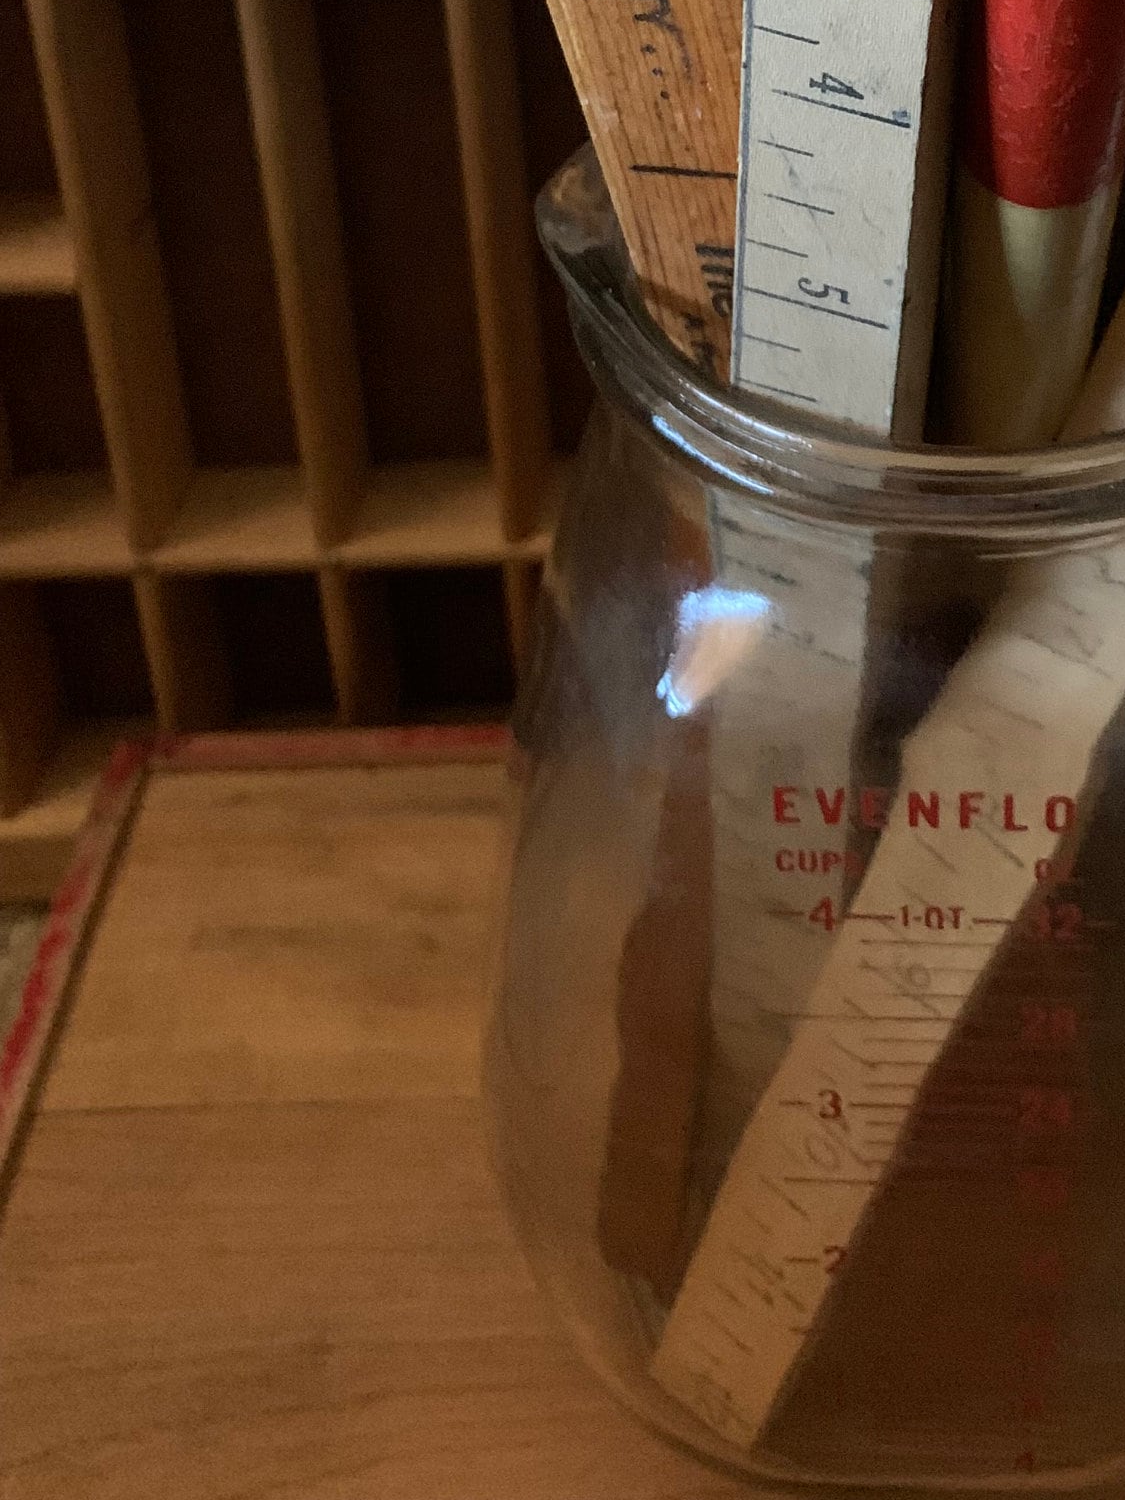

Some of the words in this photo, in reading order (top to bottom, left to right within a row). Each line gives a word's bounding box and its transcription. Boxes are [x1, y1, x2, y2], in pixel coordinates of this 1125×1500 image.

[807, 72, 866, 100] 4
[797, 275, 851, 312] 5
[771, 785, 1080, 833] EVENFLO
[808, 896, 838, 932] 4
[817, 1088, 843, 1120] 3
[822, 1245, 849, 1274] 2
